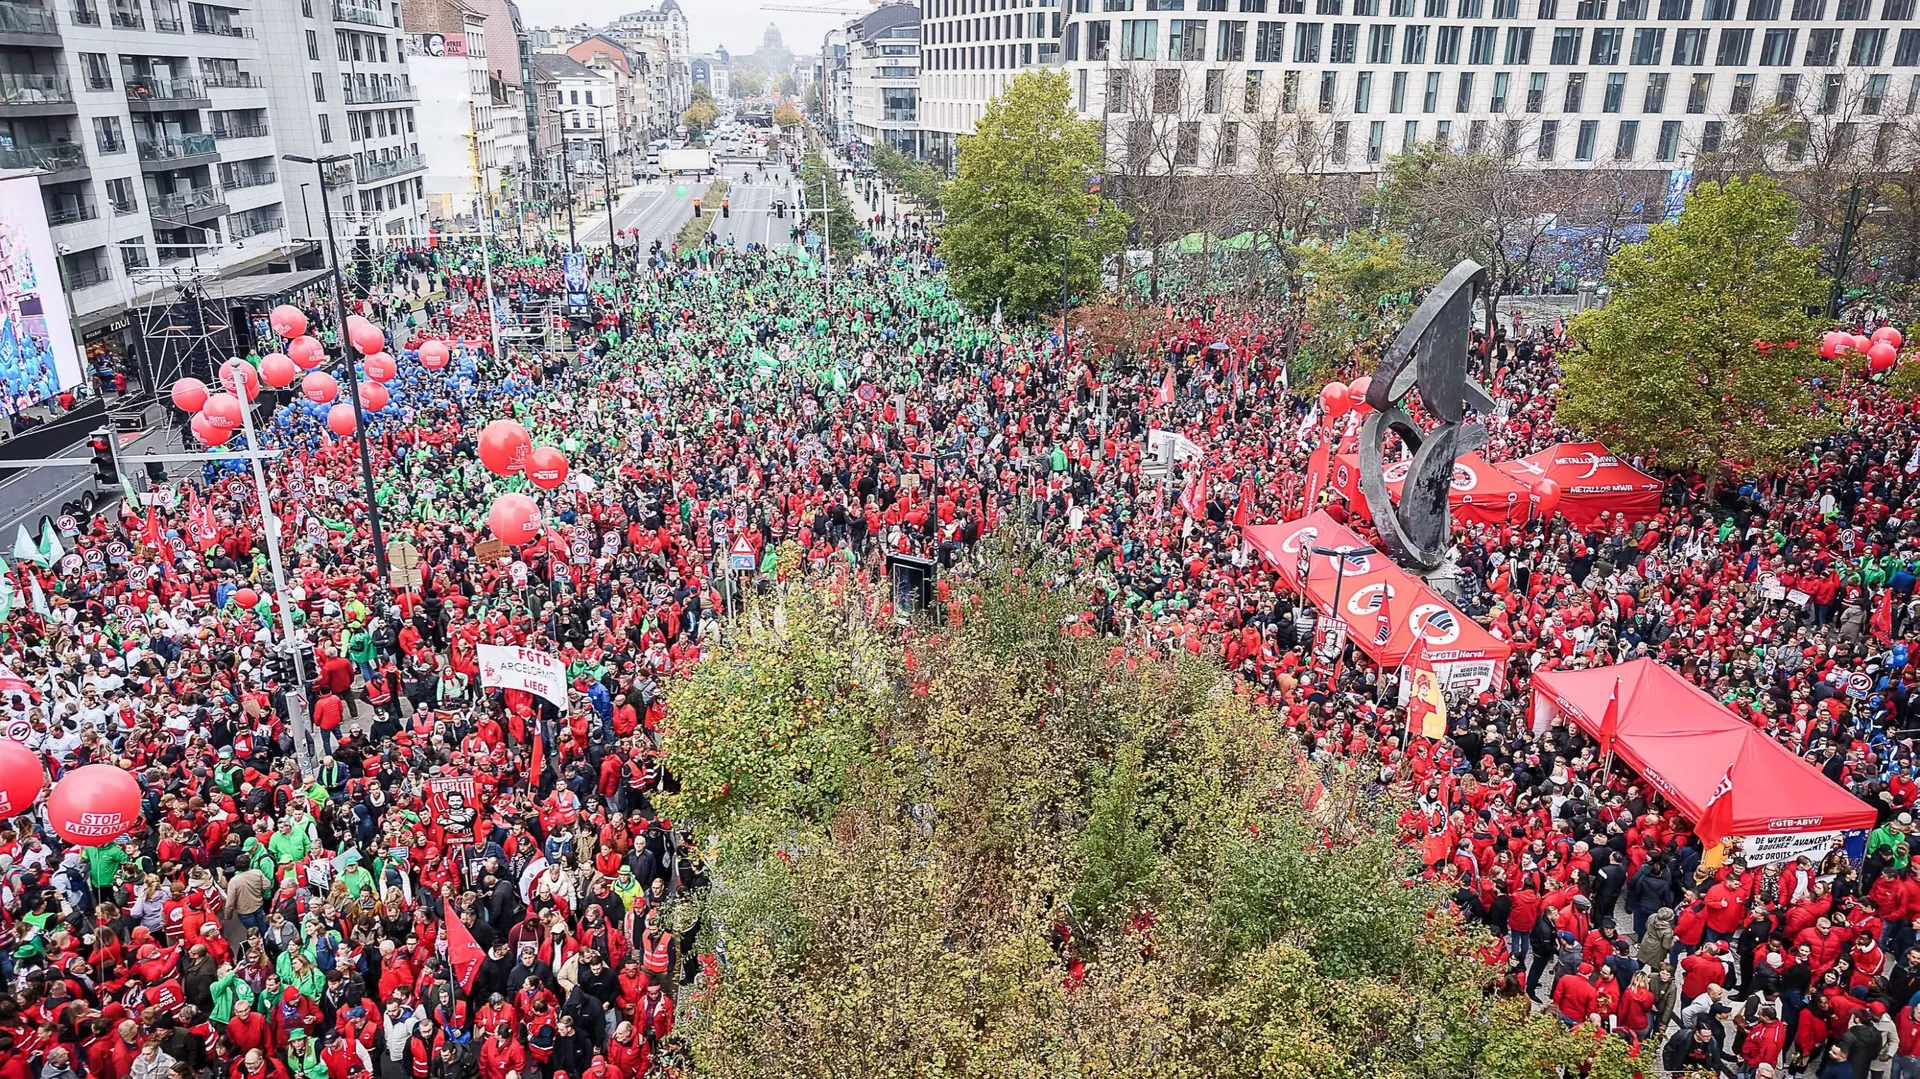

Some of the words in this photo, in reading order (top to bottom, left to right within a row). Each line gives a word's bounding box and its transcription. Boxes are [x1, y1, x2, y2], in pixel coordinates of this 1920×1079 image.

[232, 484, 242, 492] 67
[291, 482, 301, 490] 67
[1570, 486, 1610, 494] METALLOS
[63, 519, 73, 527] 67
[111, 545, 122, 554] 67
[575, 546, 585, 554] 67
[88, 552, 98, 561] 67
[132, 568, 143, 578] 67
[524, 679, 548, 694] LIEGE
[12, 726, 28, 736] 67
[83, 814, 120, 824] STOP
[68, 822, 128, 836] ARIZONA
[1758, 842, 1790, 851] BOUCHEZ
[1765, 851, 1791, 860] DROITS
